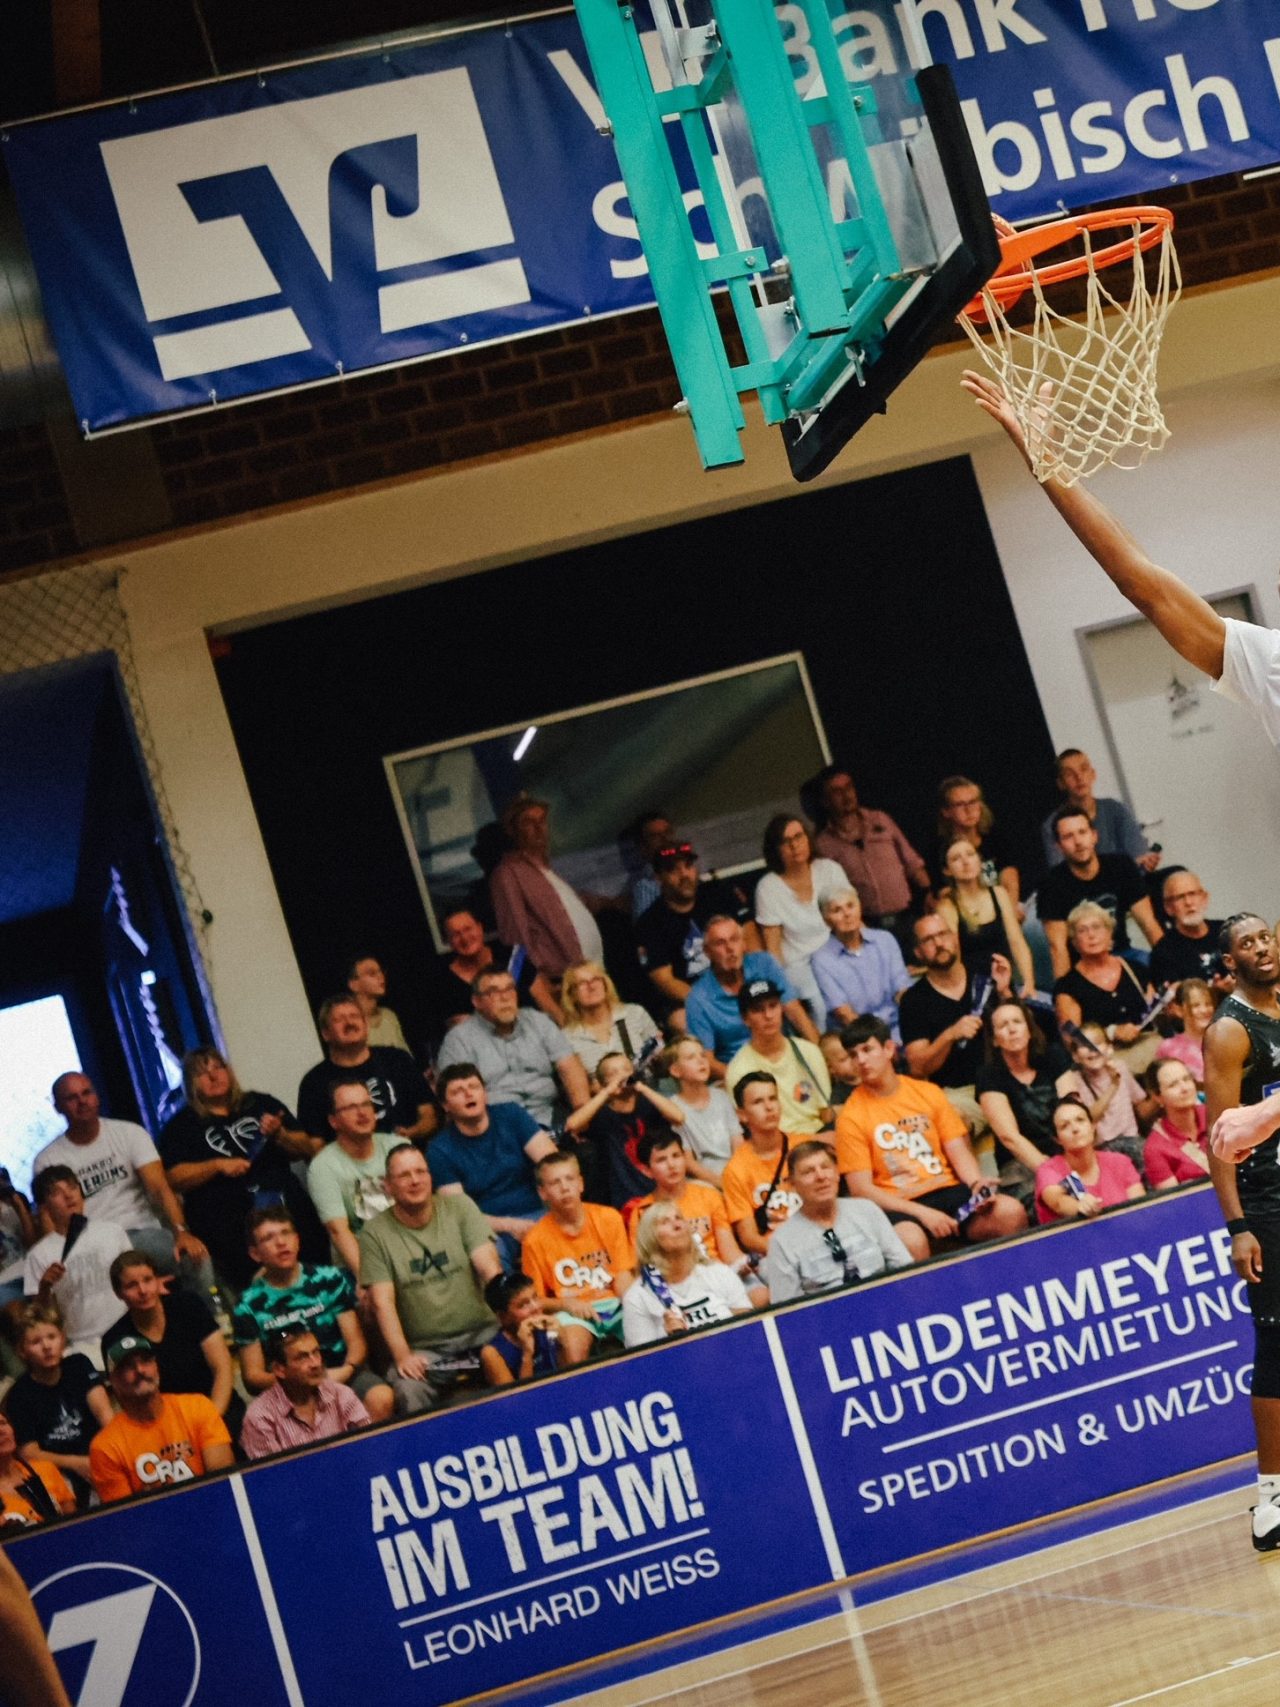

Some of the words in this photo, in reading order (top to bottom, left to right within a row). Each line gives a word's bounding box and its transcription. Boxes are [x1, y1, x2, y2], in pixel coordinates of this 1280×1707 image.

[370, 1391, 682, 1533] AUSBILDUNG
[858, 1423, 1066, 1514] SPEDITION
[1078, 1412, 1108, 1446] &
[376, 1518, 471, 1610] IM
[480, 1447, 706, 1574] TEAM!
[404, 1585, 601, 1671] LEONHARD
[606, 1548, 720, 1605] WEISS
